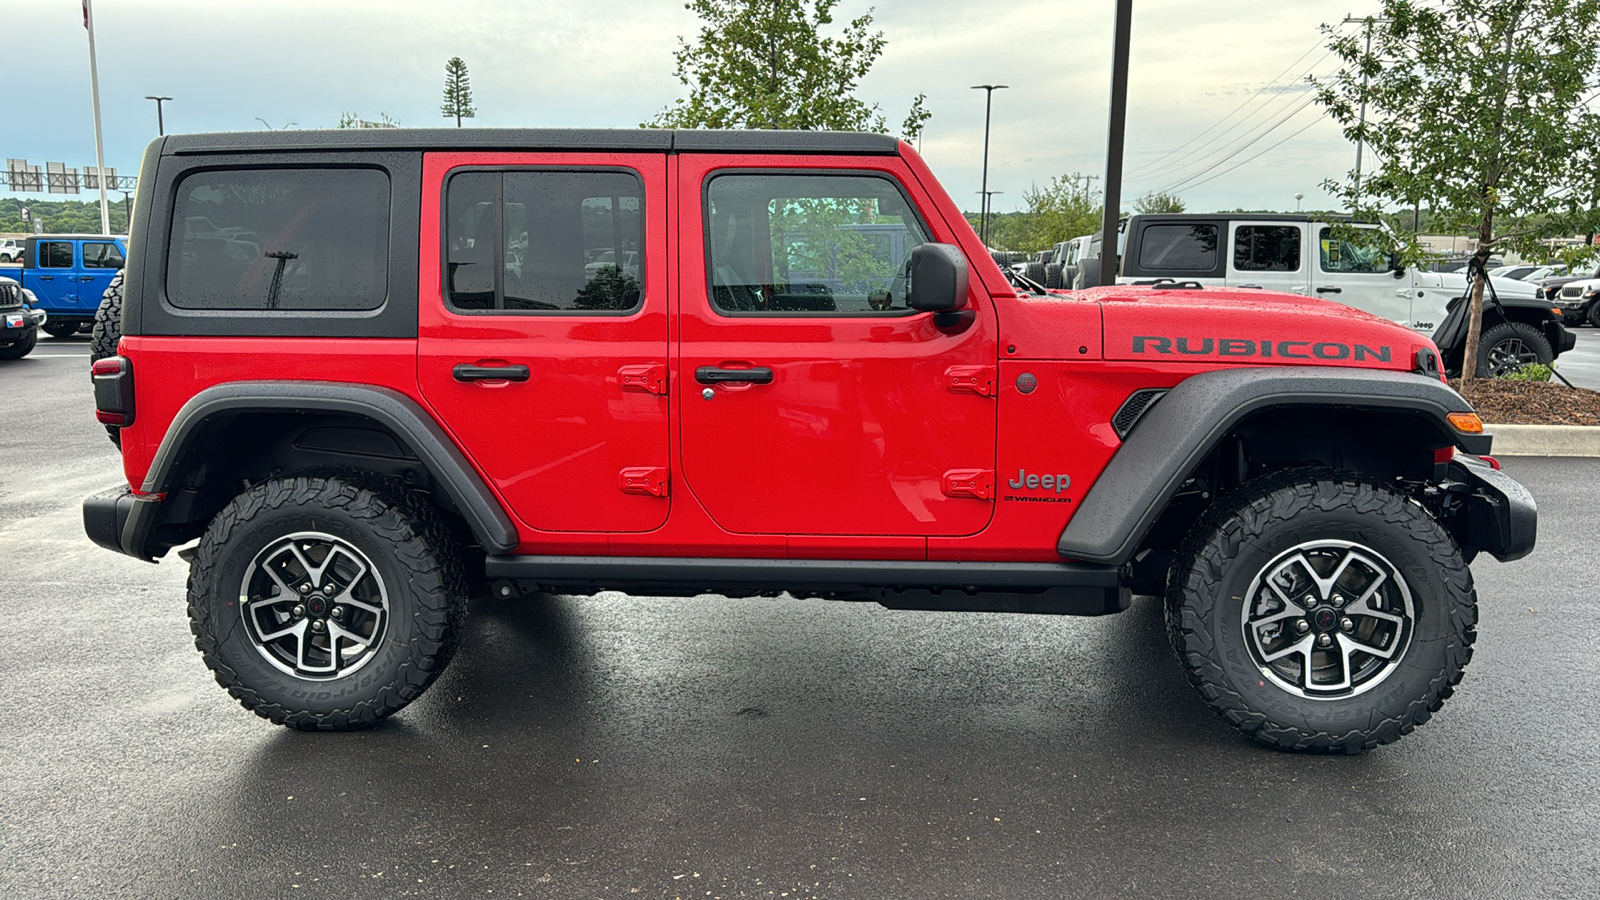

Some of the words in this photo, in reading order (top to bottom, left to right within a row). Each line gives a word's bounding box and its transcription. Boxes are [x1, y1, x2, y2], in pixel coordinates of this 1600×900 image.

[1413, 321, 1434, 330] Jeep
[1132, 335, 1392, 362] RUBICON
[1008, 469, 1071, 493] Jeep
